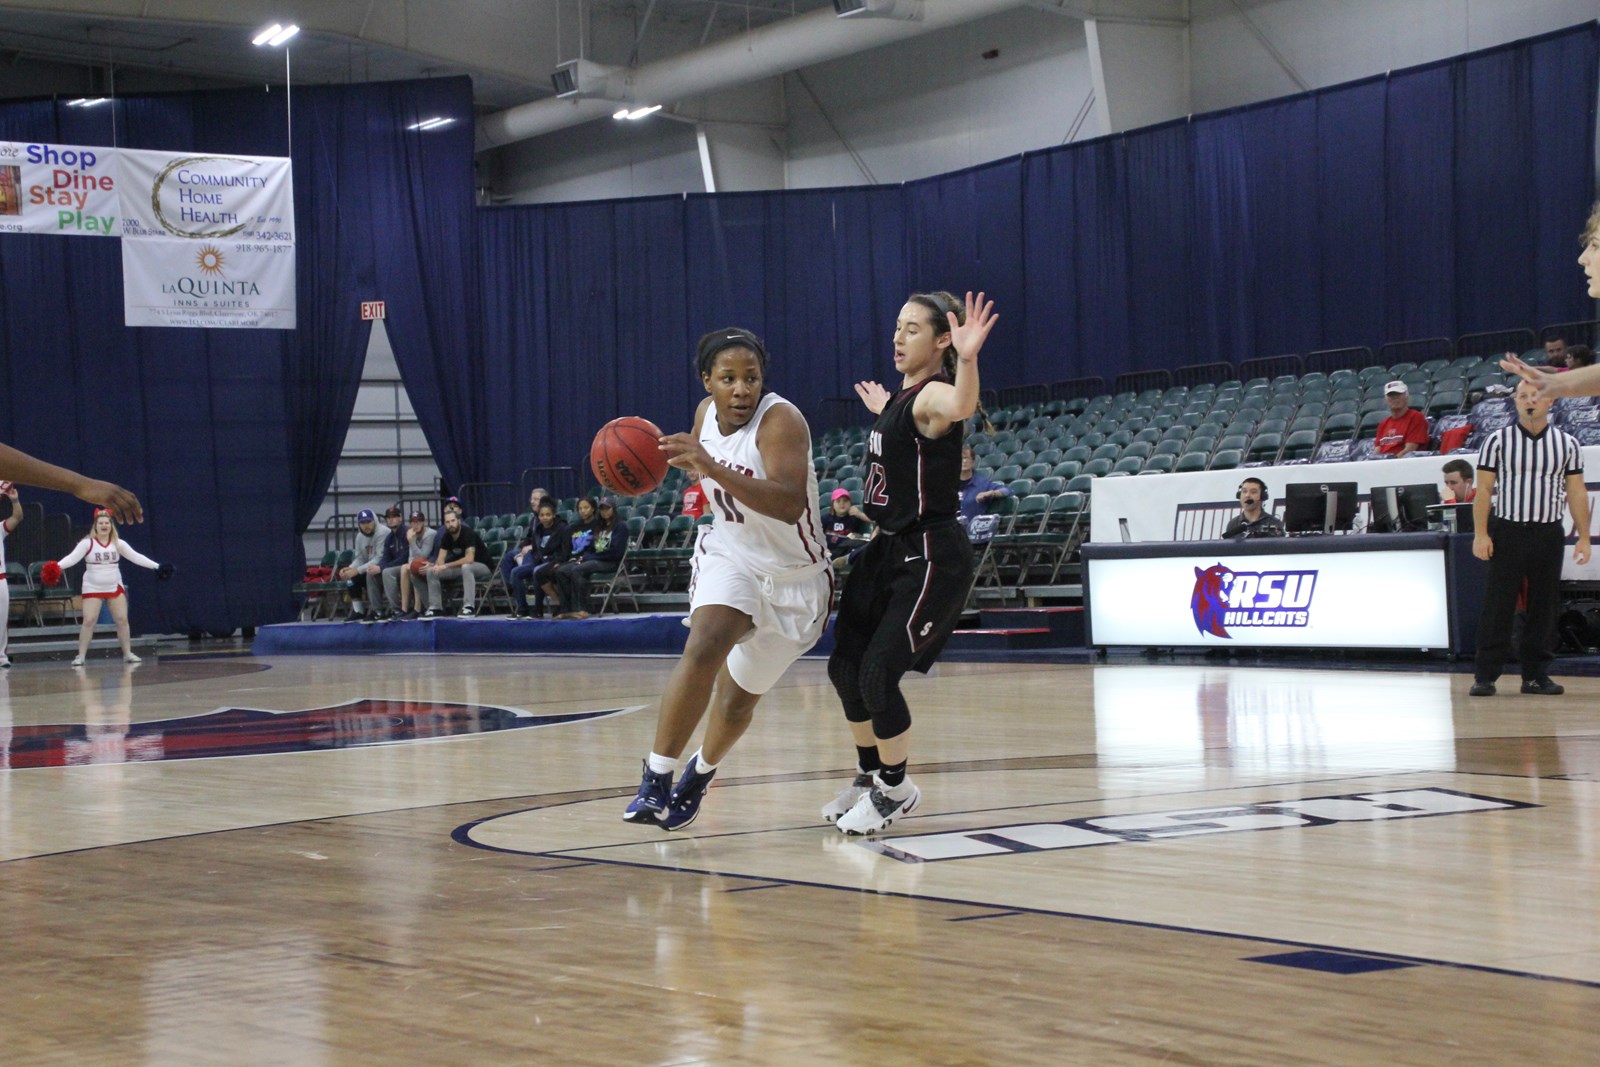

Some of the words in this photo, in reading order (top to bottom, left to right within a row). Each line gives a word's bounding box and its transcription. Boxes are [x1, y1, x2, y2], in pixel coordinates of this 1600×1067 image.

[26, 144, 97, 170] Shop
[53, 169, 114, 191] Dine
[177, 169, 268, 189] COMMUNITY
[29, 184, 89, 211] Stay
[179, 187, 223, 205] HOME
[58, 210, 115, 235] Play
[180, 206, 238, 224] HEALTH
[173, 299, 198, 307] INNS
[362, 303, 384, 319] EXIT
[863, 462, 889, 506] 12
[713, 487, 745, 524] 11
[95, 551, 117, 562] RSU
[1228, 574, 1316, 609] RSU
[1223, 610, 1309, 626] HILLCATS
